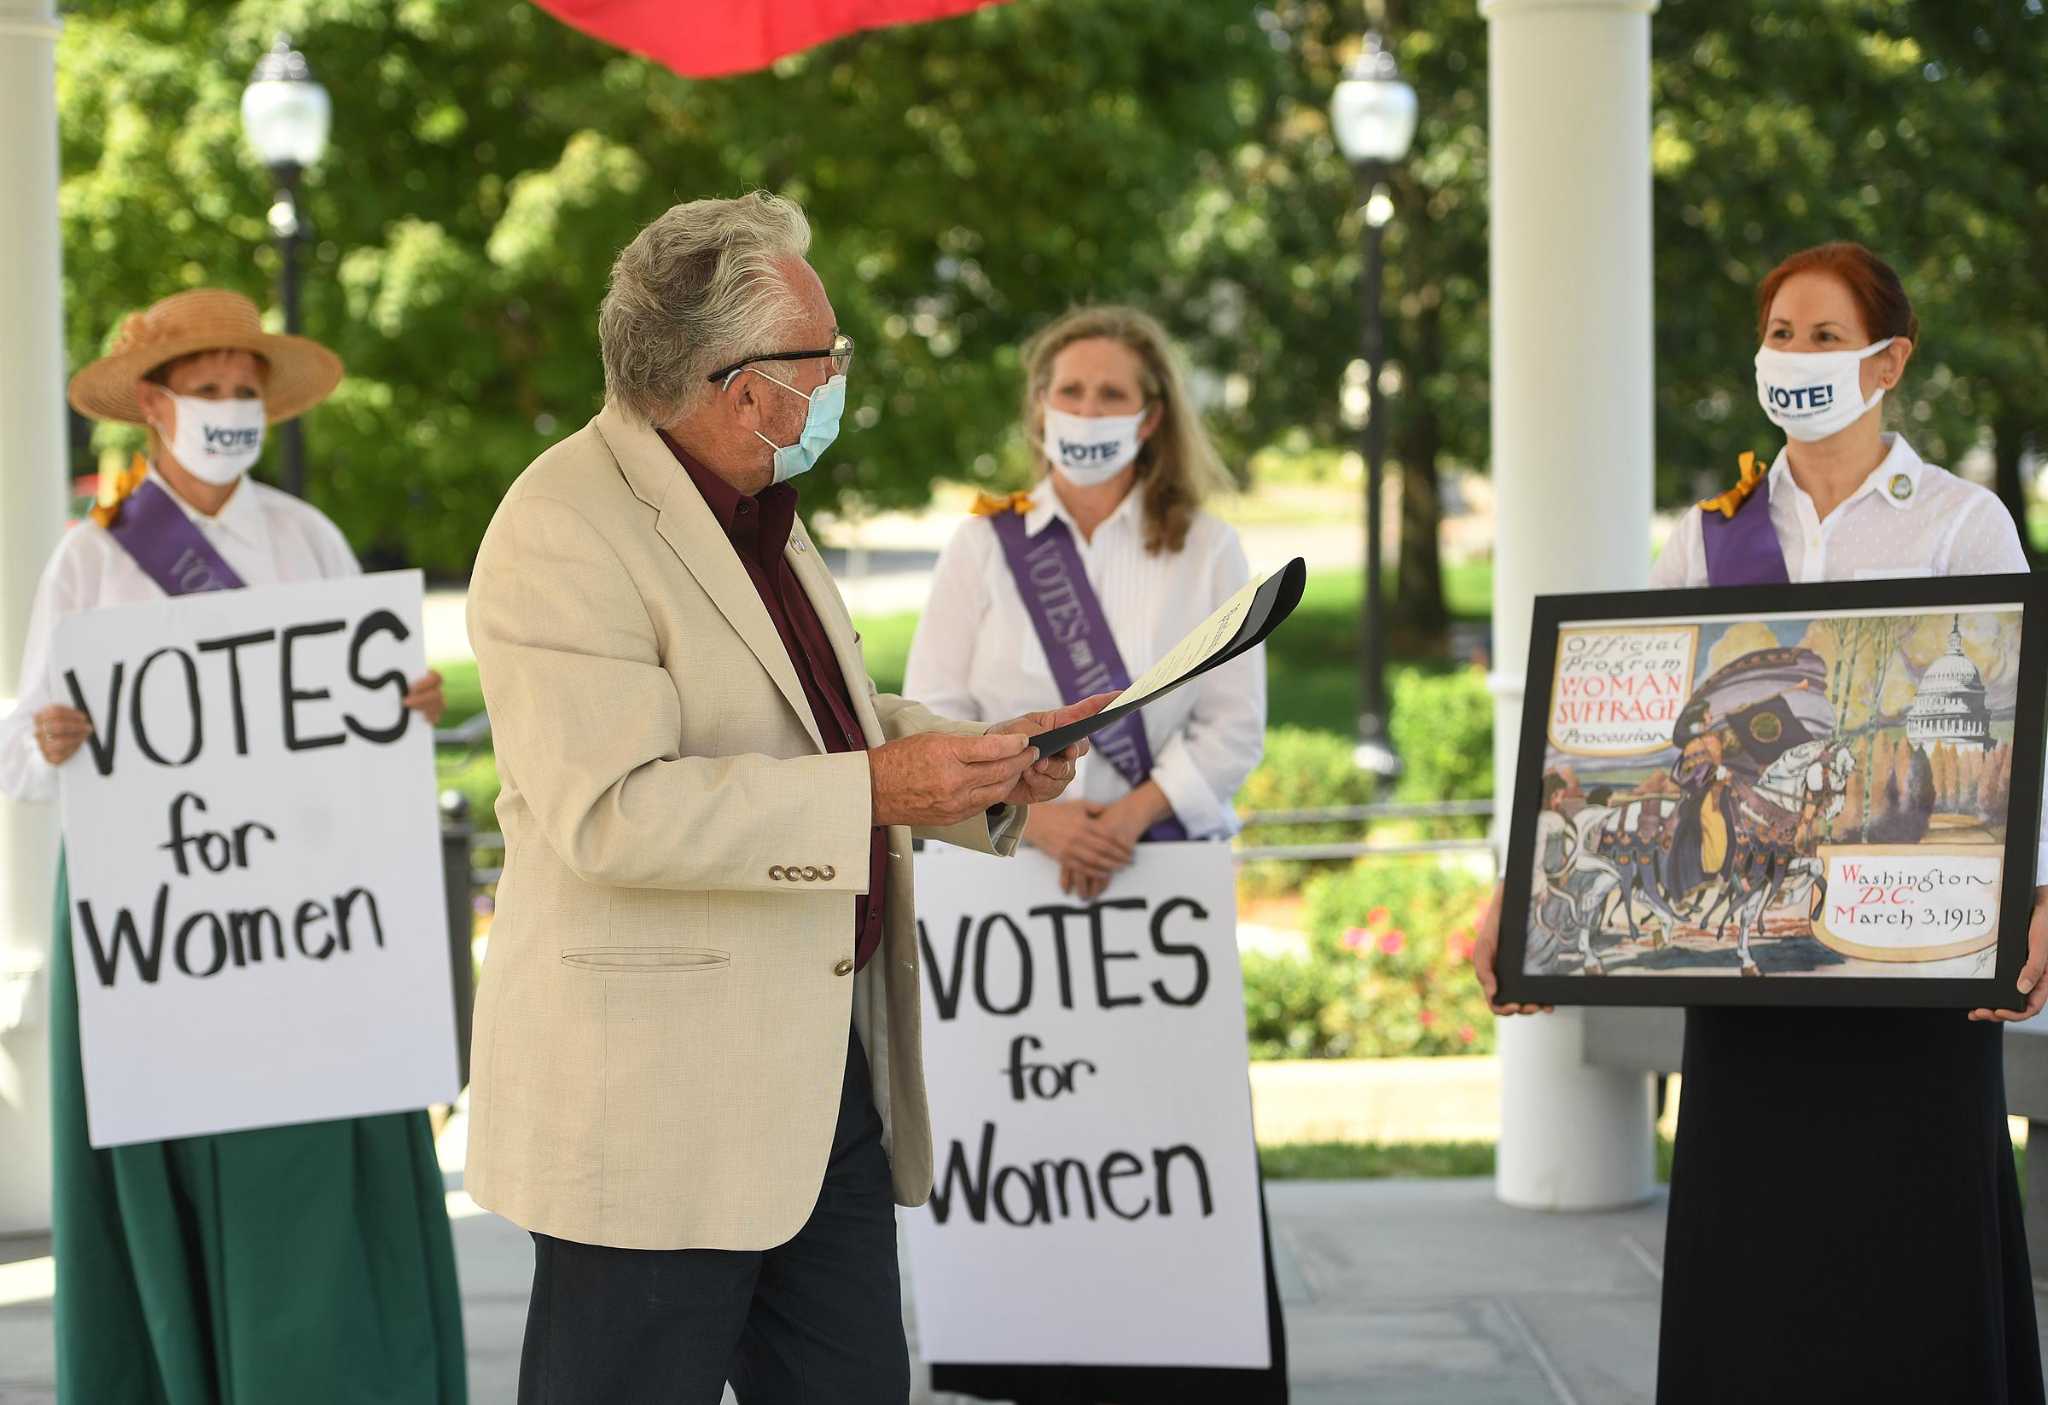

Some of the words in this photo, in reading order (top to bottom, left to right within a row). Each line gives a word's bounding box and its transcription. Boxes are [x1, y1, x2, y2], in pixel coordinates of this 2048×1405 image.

[1567, 632, 1690, 658] Official
[1562, 651, 1682, 676] Program
[64, 608, 411, 777] VOTES
[1560, 672, 1682, 697] WOMAN
[1556, 699, 1678, 724] SUFFRAGE
[158, 791, 277, 877] for
[1842, 863, 1993, 893] Washington
[1857, 885, 1915, 905] D.C.
[1834, 904, 1913, 930] March
[76, 882, 385, 988] Women
[917, 896, 1210, 1022] VOTES
[1002, 1033, 1097, 1102] for
[931, 1120, 1214, 1228] Women
